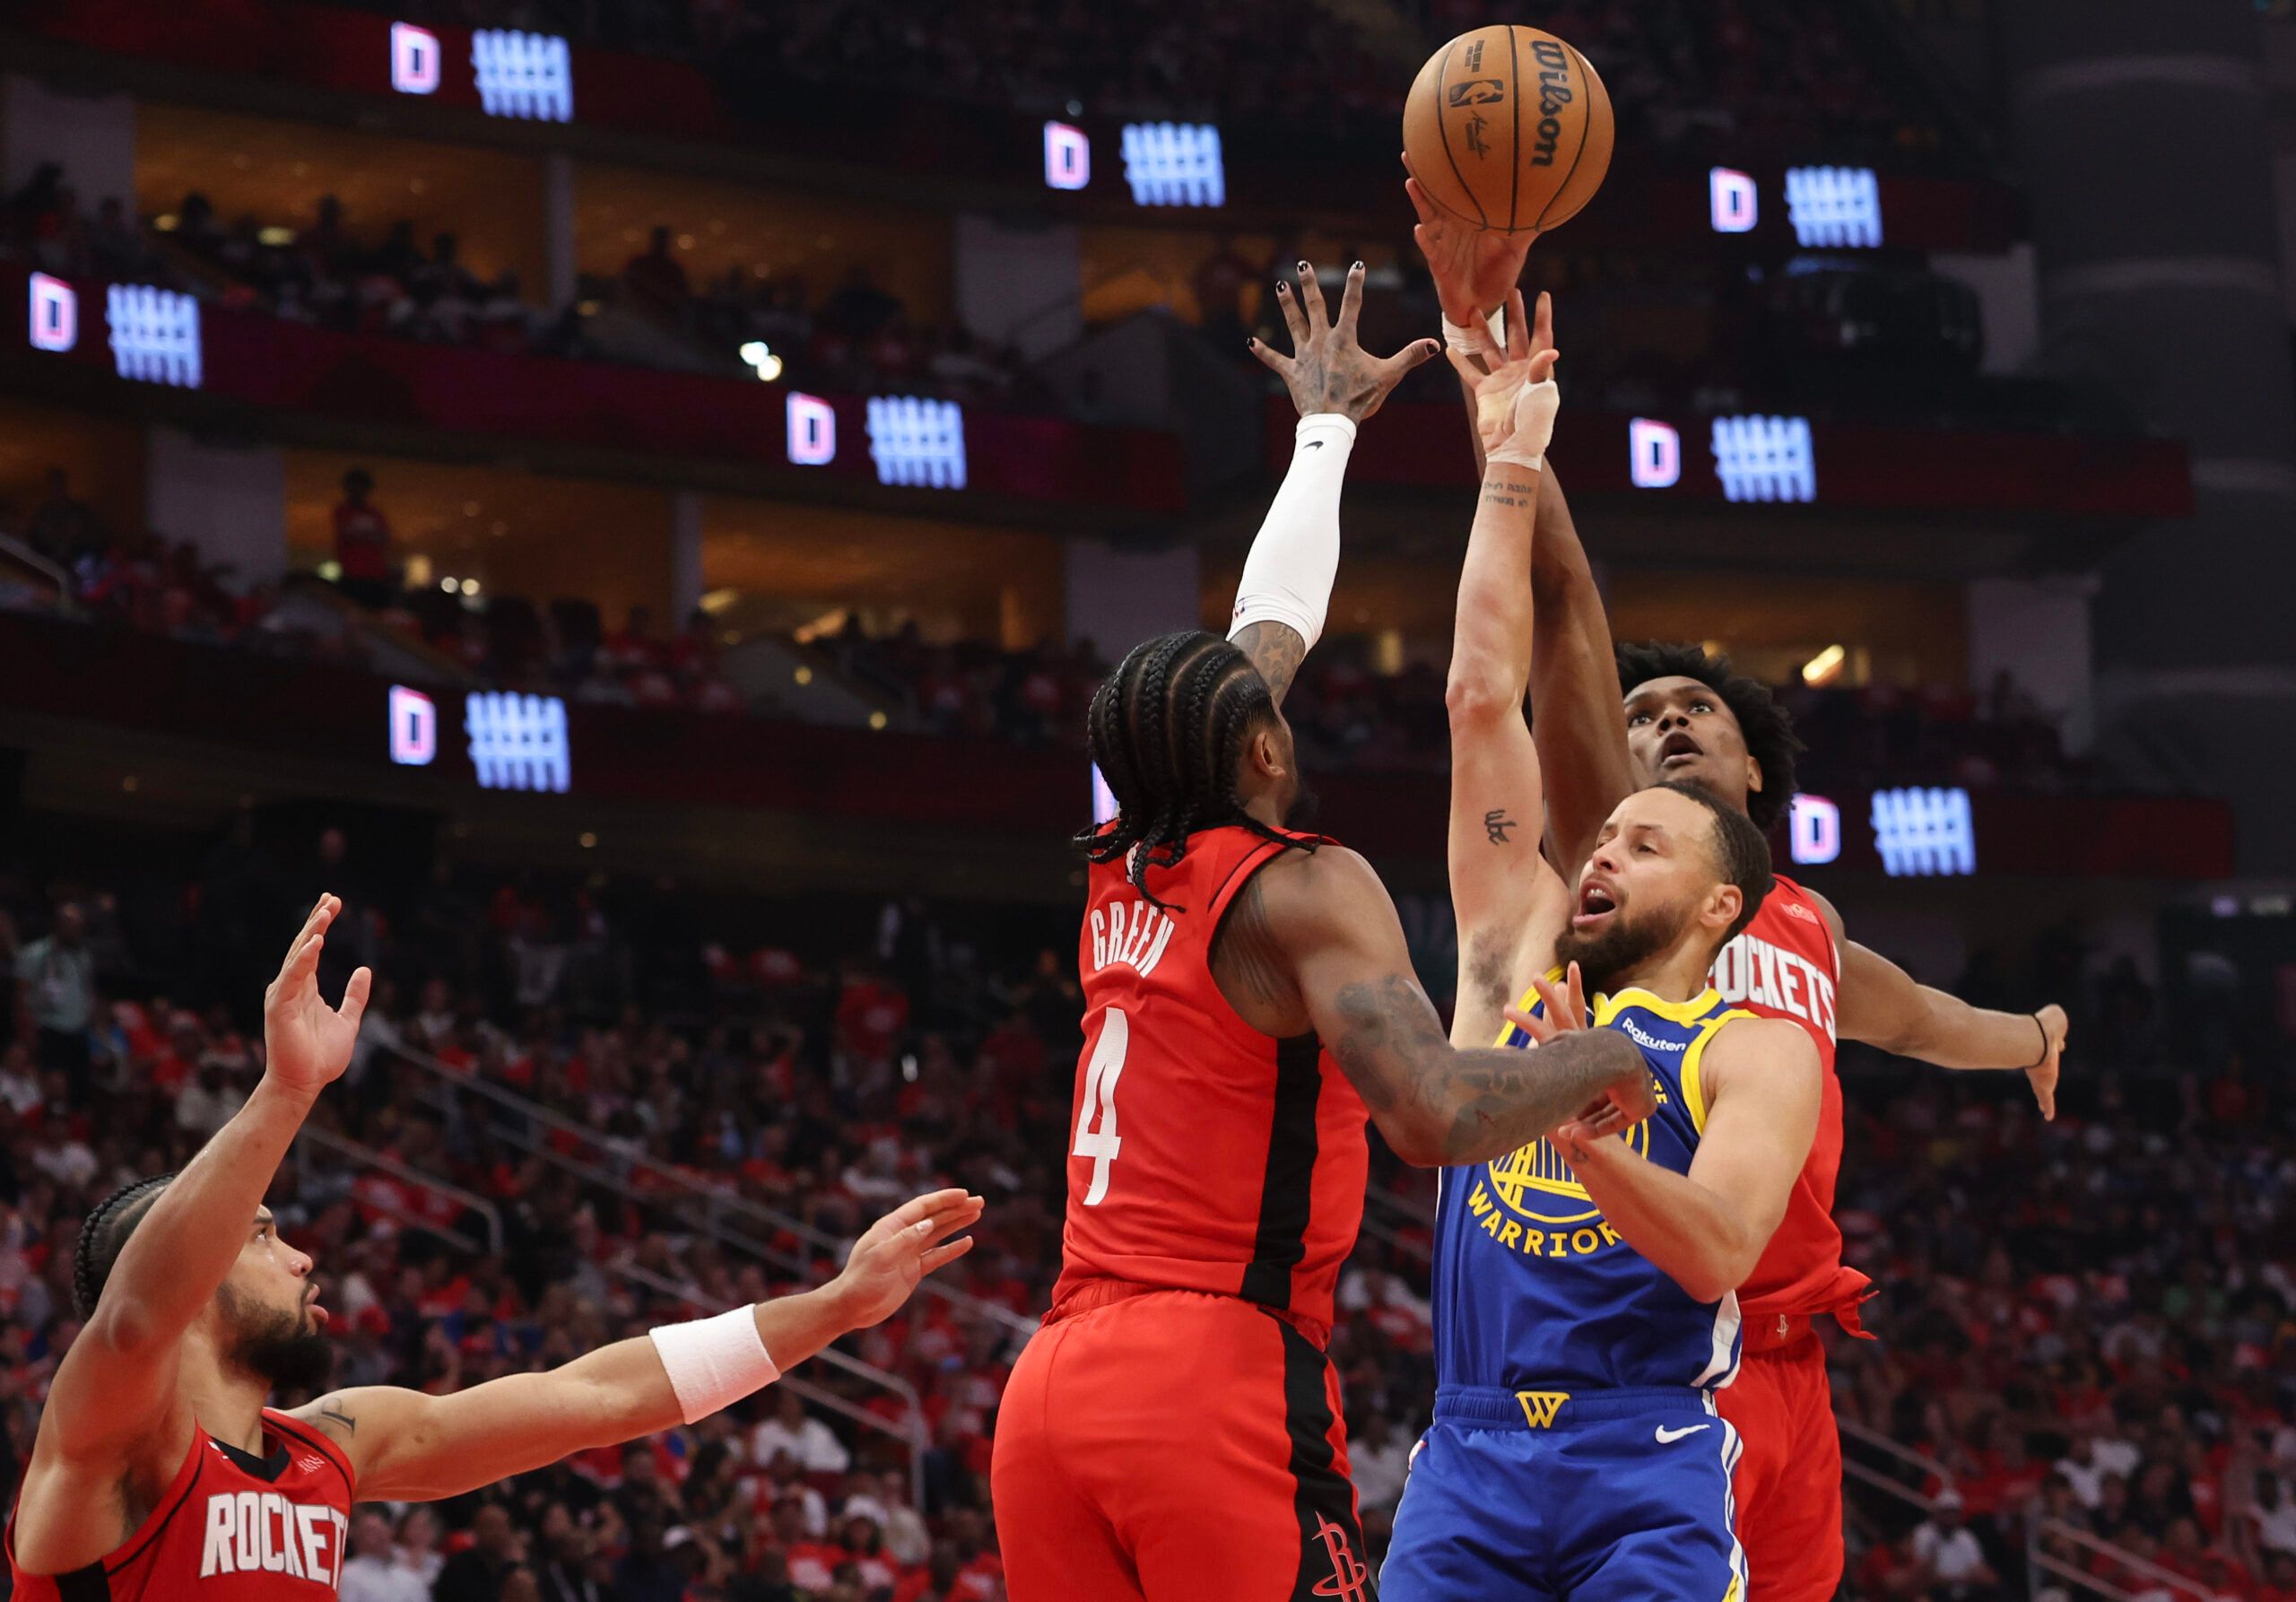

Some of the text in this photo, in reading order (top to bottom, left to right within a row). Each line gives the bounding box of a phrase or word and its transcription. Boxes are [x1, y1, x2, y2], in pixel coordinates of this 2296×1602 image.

[391, 22, 440, 94] D
[1530, 39, 1573, 166] Wilson
[1044, 122, 1090, 189] D
[1709, 168, 1758, 232] D
[30, 273, 77, 352] D
[787, 392, 836, 465] D
[1630, 418, 1681, 488] D
[389, 685, 436, 765] D
[1790, 793, 1840, 864] D
[1090, 900, 1176, 979] GREEN
[1705, 933, 1837, 1049] OCKETS
[1622, 1016, 1686, 1052] Rakuten
[1072, 1006, 1129, 1206] 4
[1467, 1180, 1622, 1258] WARRIOR
[200, 1490, 349, 1593] ROCKET
